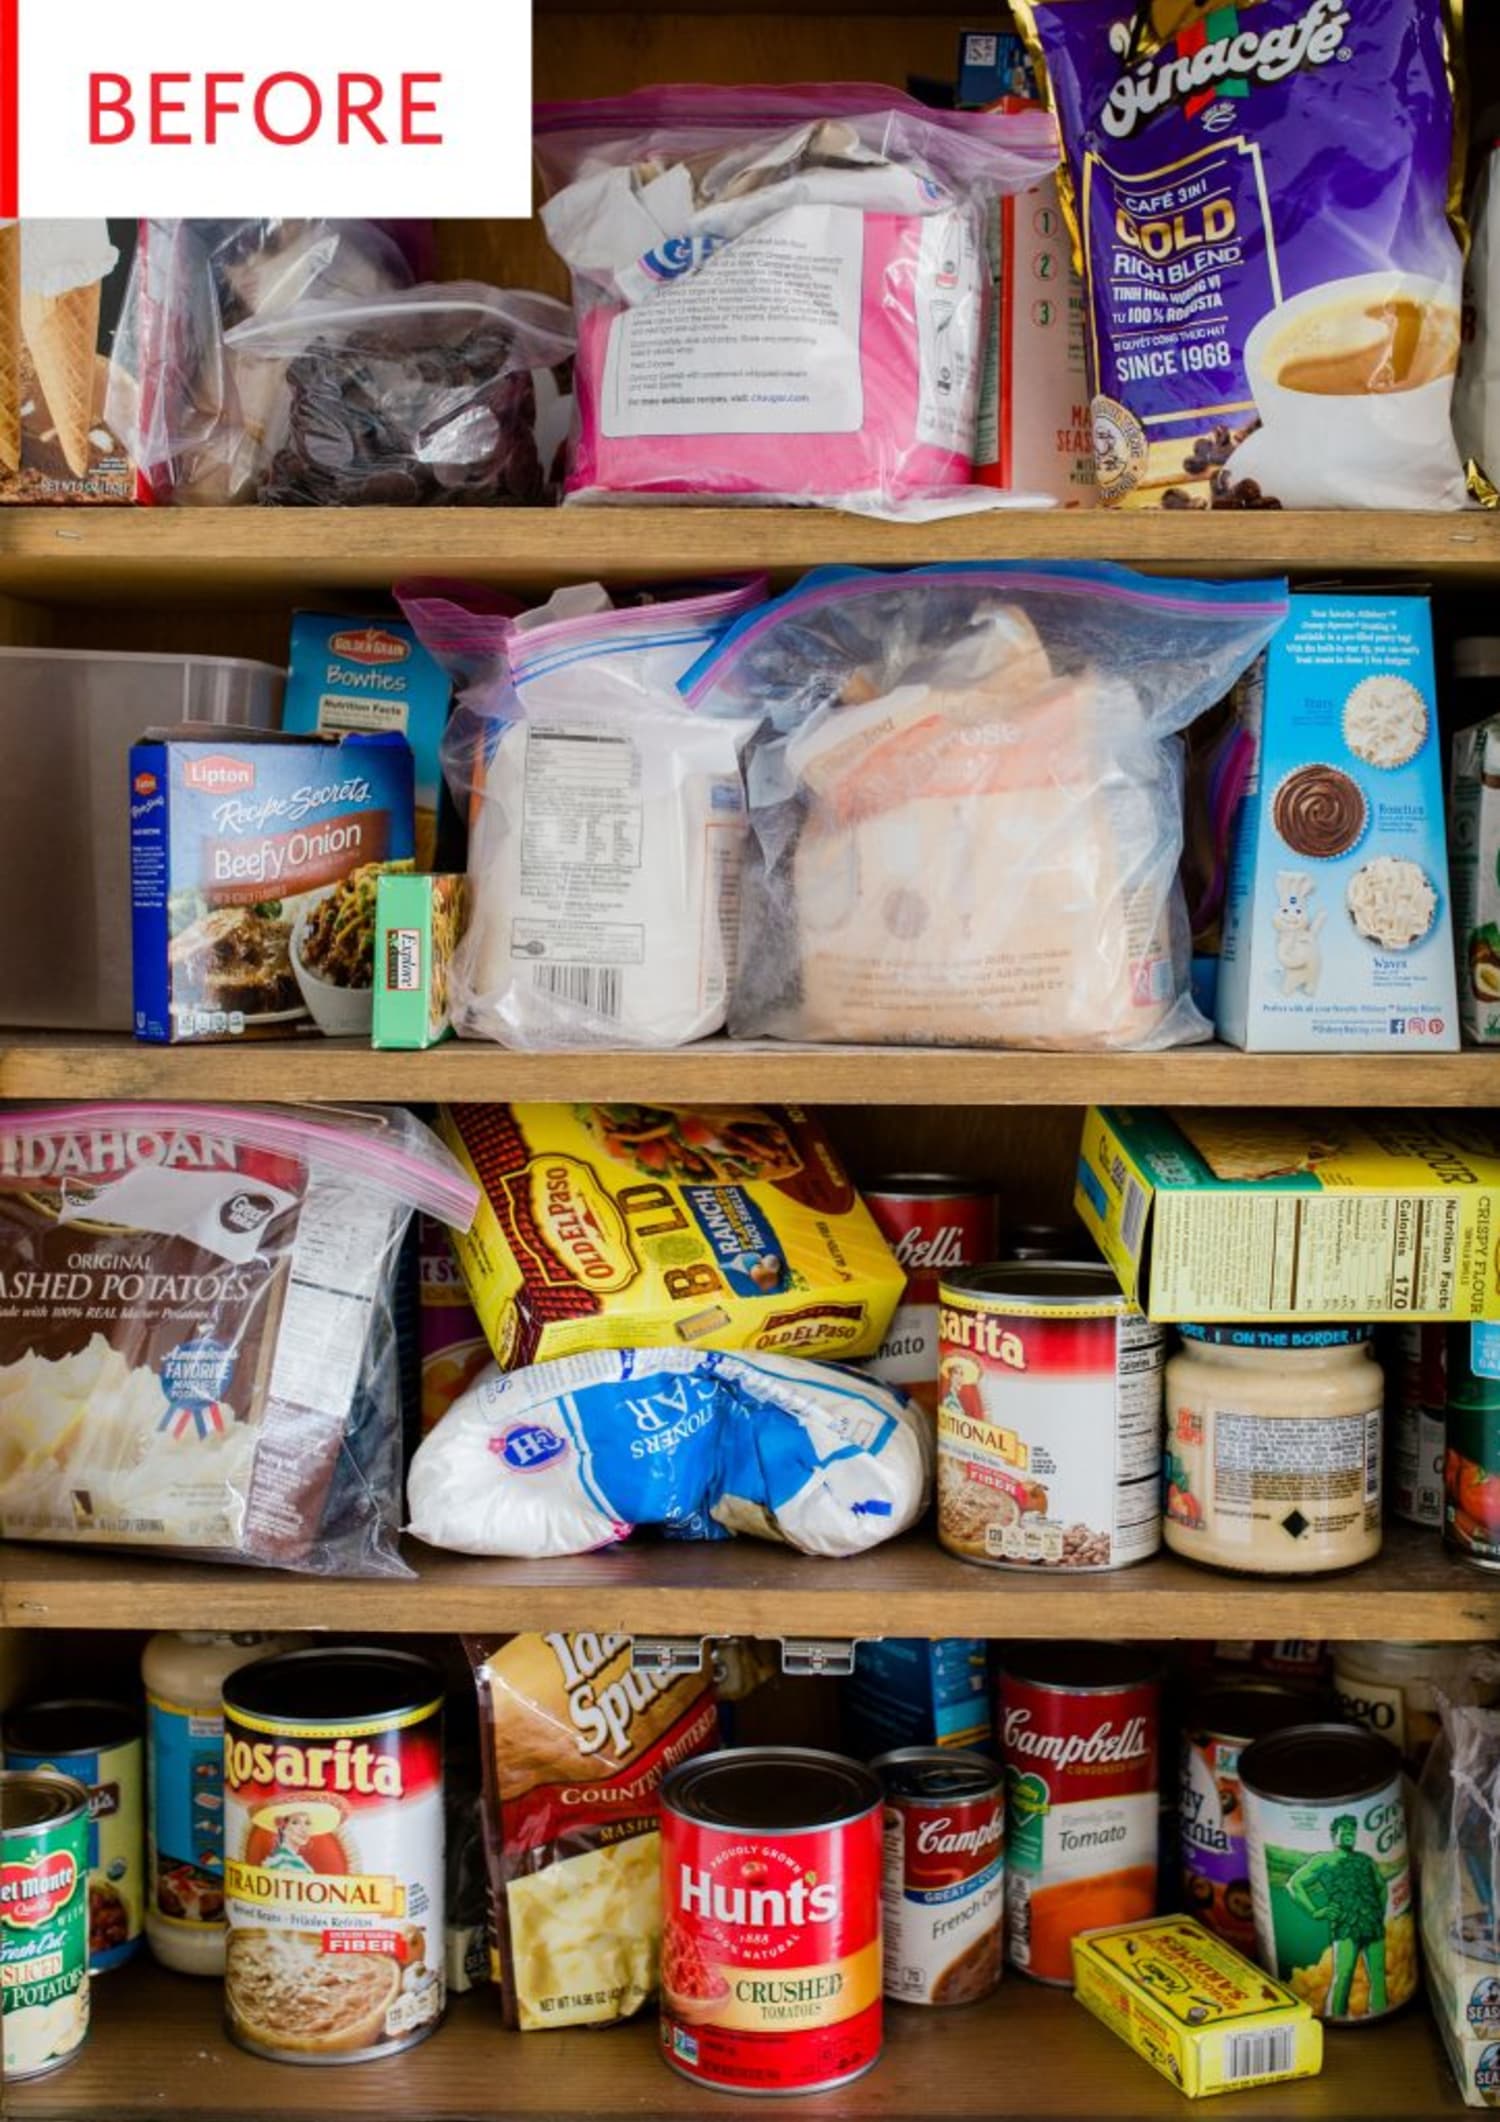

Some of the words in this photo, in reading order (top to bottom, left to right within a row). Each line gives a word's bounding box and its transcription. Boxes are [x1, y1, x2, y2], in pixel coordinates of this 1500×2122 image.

[1041, 215, 1051, 232] 1
[1115, 198, 1237, 260] GOLD
[1039, 257, 1051, 276] 2
[1113, 252, 1165, 284] RICH
[1167, 246, 1242, 285] BLEND
[1038, 305, 1051, 324] 3
[1115, 349, 1177, 382] SINCE
[1181, 340, 1232, 372] 1968
[326, 664, 407, 691] Bowties
[323, 698, 370, 711] Nutrition
[373, 702, 403, 715] Facts
[192, 766, 250, 787] Lipton
[211, 797, 289, 835] Recipe
[286, 776, 372, 821] Secrets
[214, 839, 286, 883] Beefy
[287, 823, 362, 865] Onion
[1373, 957, 1408, 969] Waves
[0, 1128, 238, 1178] IDAHOAN
[692, 1189, 742, 1255] RANCH
[747, 1220, 766, 1251] TACO
[1397, 1199, 1412, 1257] Calories
[1442, 1199, 1457, 1263] Nutrition
[1476, 1195, 1491, 1258] CRISPY
[67, 1252, 152, 1270] ORIGINAL
[571, 1239, 615, 1280] OLD
[895, 1225, 965, 1267] bell's
[0, 1271, 93, 1301] SHED
[101, 1273, 253, 1302] POTATOES
[1394, 1275, 1409, 1309] 170
[1438, 1272, 1453, 1310] Facts
[1470, 1260, 1487, 1315] FLOUR
[23, 1307, 49, 1318] with
[51, 1307, 82, 1319] 100%
[86, 1307, 118, 1319] REAL
[161, 1308, 209, 1320] Potatoes
[755, 1329, 792, 1350] OLD
[878, 1335, 926, 1360] mato
[940, 1307, 1028, 1370] sarita
[1231, 1330, 1256, 1344] ON
[1258, 1331, 1289, 1346] THE
[1291, 1329, 1349, 1346] BORDER
[948, 1414, 1008, 1453] TIONAL
[545, 1632, 632, 1692] Ida
[568, 1668, 680, 1756] Spu
[560, 1760, 665, 1807] COUNTRY
[661, 1702, 719, 1771] BUTTERED
[1004, 1707, 1149, 1772] Campbell's
[224, 1739, 404, 1797] Rosarita
[1065, 1762, 1125, 1776] CONDENSED
[599, 1816, 661, 1843] MASHE
[1057, 1822, 1127, 1852] Tomato
[709, 1845, 759, 1870] PROUDLY
[760, 1846, 803, 1875] GROWN
[21, 1867, 73, 1900] Monte
[227, 1868, 381, 1906] TRADITIONAL
[679, 1862, 841, 1927] Hunt's
[923, 1884, 966, 1905] GREAT
[931, 1902, 980, 1940] French
[328, 1939, 397, 1952] FIBER
[742, 1933, 801, 1960] NATURAL
[2, 1953, 62, 1984] SLICED
[11, 1966, 85, 2010] POTATOES
[735, 1972, 844, 2004] CRUSHED
[760, 2004, 823, 2021] TOMATOES
[1467, 2005, 1500, 2021] SEAS
[1476, 2071, 1500, 2087] SEA
